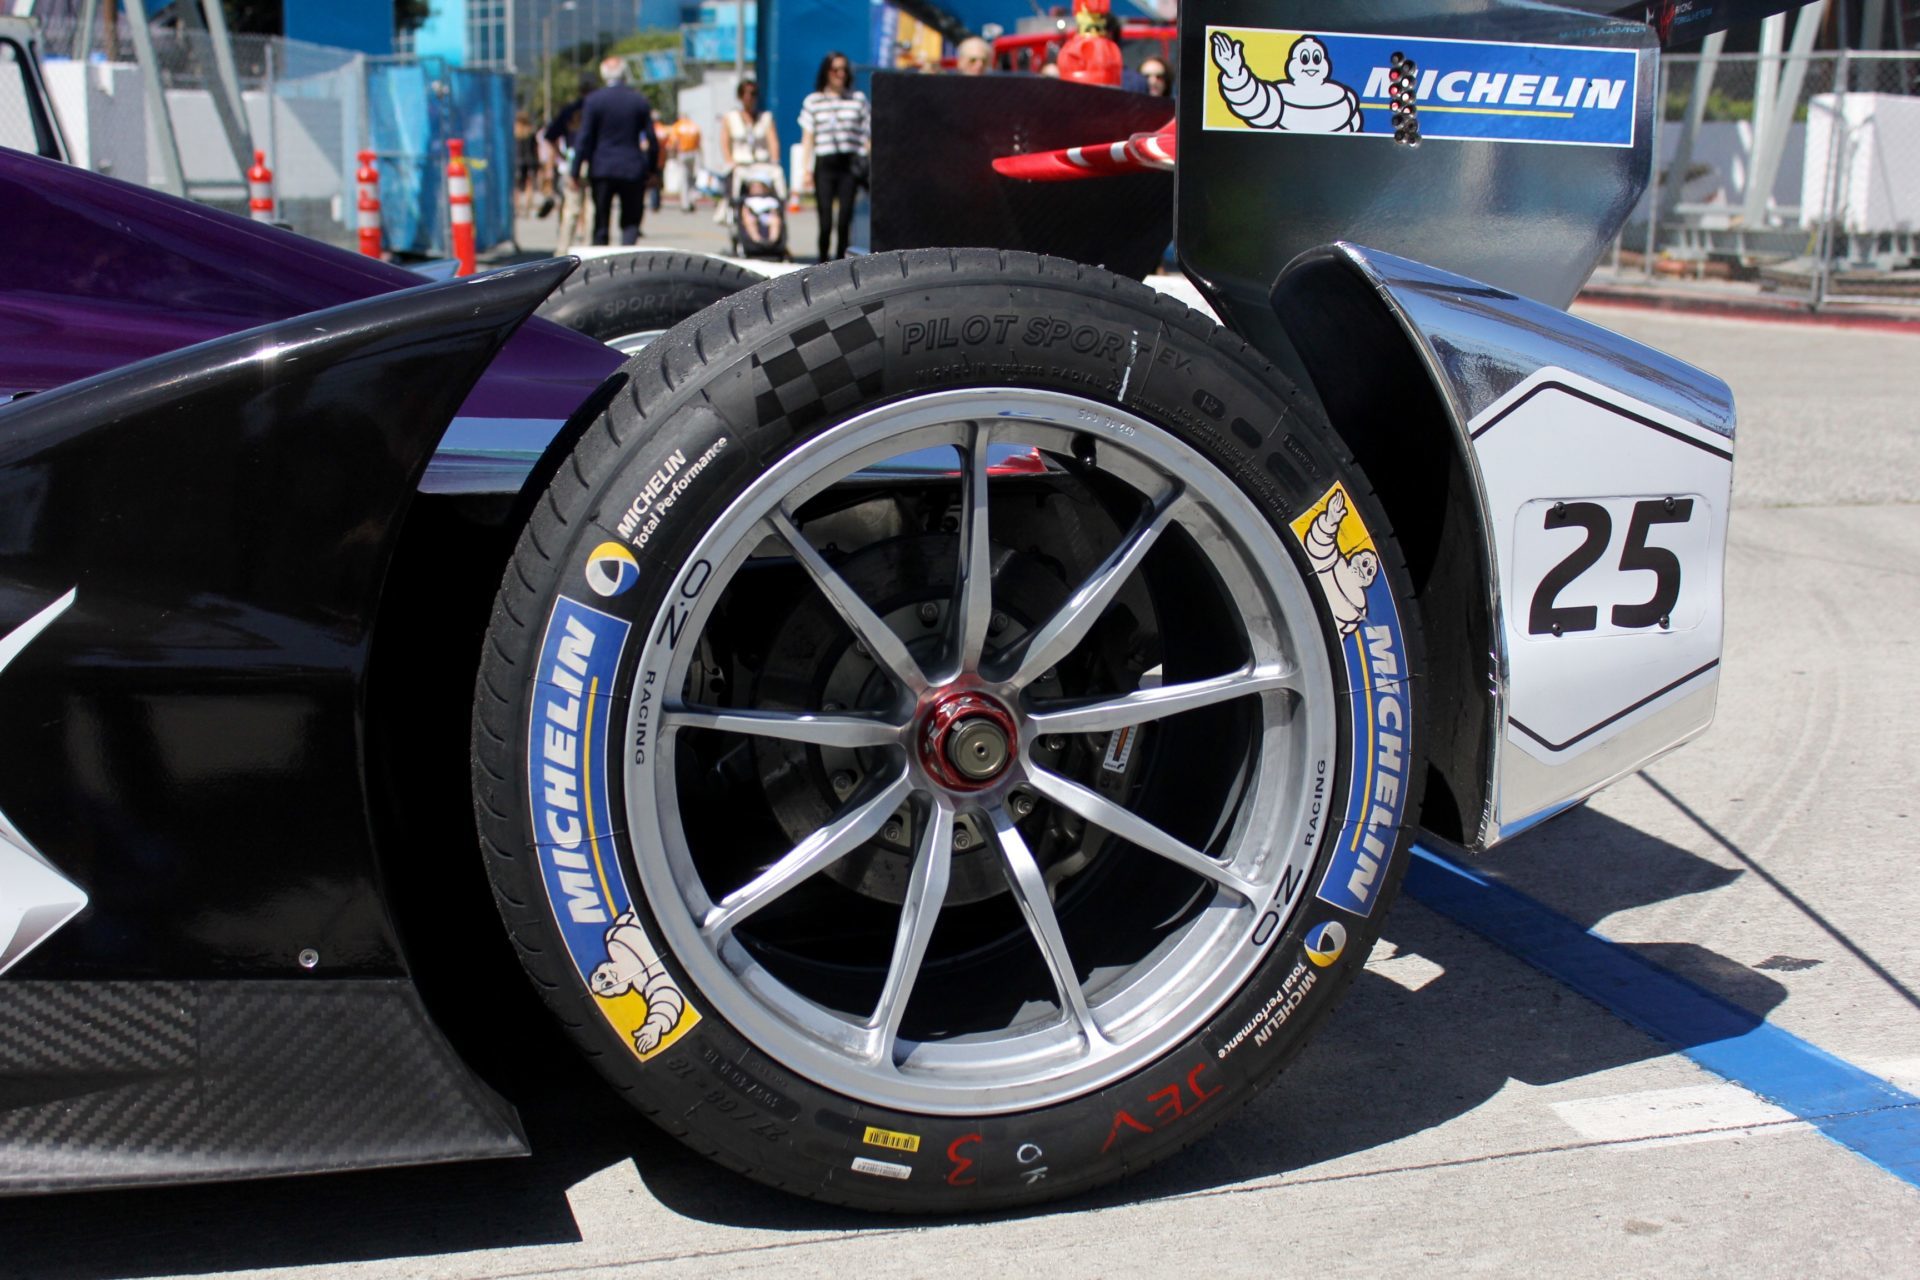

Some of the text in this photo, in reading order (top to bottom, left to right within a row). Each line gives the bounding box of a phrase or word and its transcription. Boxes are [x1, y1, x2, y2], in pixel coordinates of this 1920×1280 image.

[1362, 67, 1626, 109] MICHELIN
[604, 294, 669, 318] SPORT
[902, 315, 1019, 355] PILOT
[616, 449, 687, 539] MICHELIN
[632, 436, 727, 549] Total Performance
[1528, 498, 1694, 635] 25
[635, 670, 656, 766] RACING
[544, 615, 606, 924] MICHELIN
[1304, 759, 1326, 847] RACING
[1347, 625, 1402, 903] MICHELIN
[1217, 962, 1307, 1059] Total Performance
[1254, 970, 1318, 1047] MICHELIN
[1103, 1063, 1224, 1153] JEV
[947, 1132, 982, 1186] 3
[1016, 1143, 1048, 1185] OK
